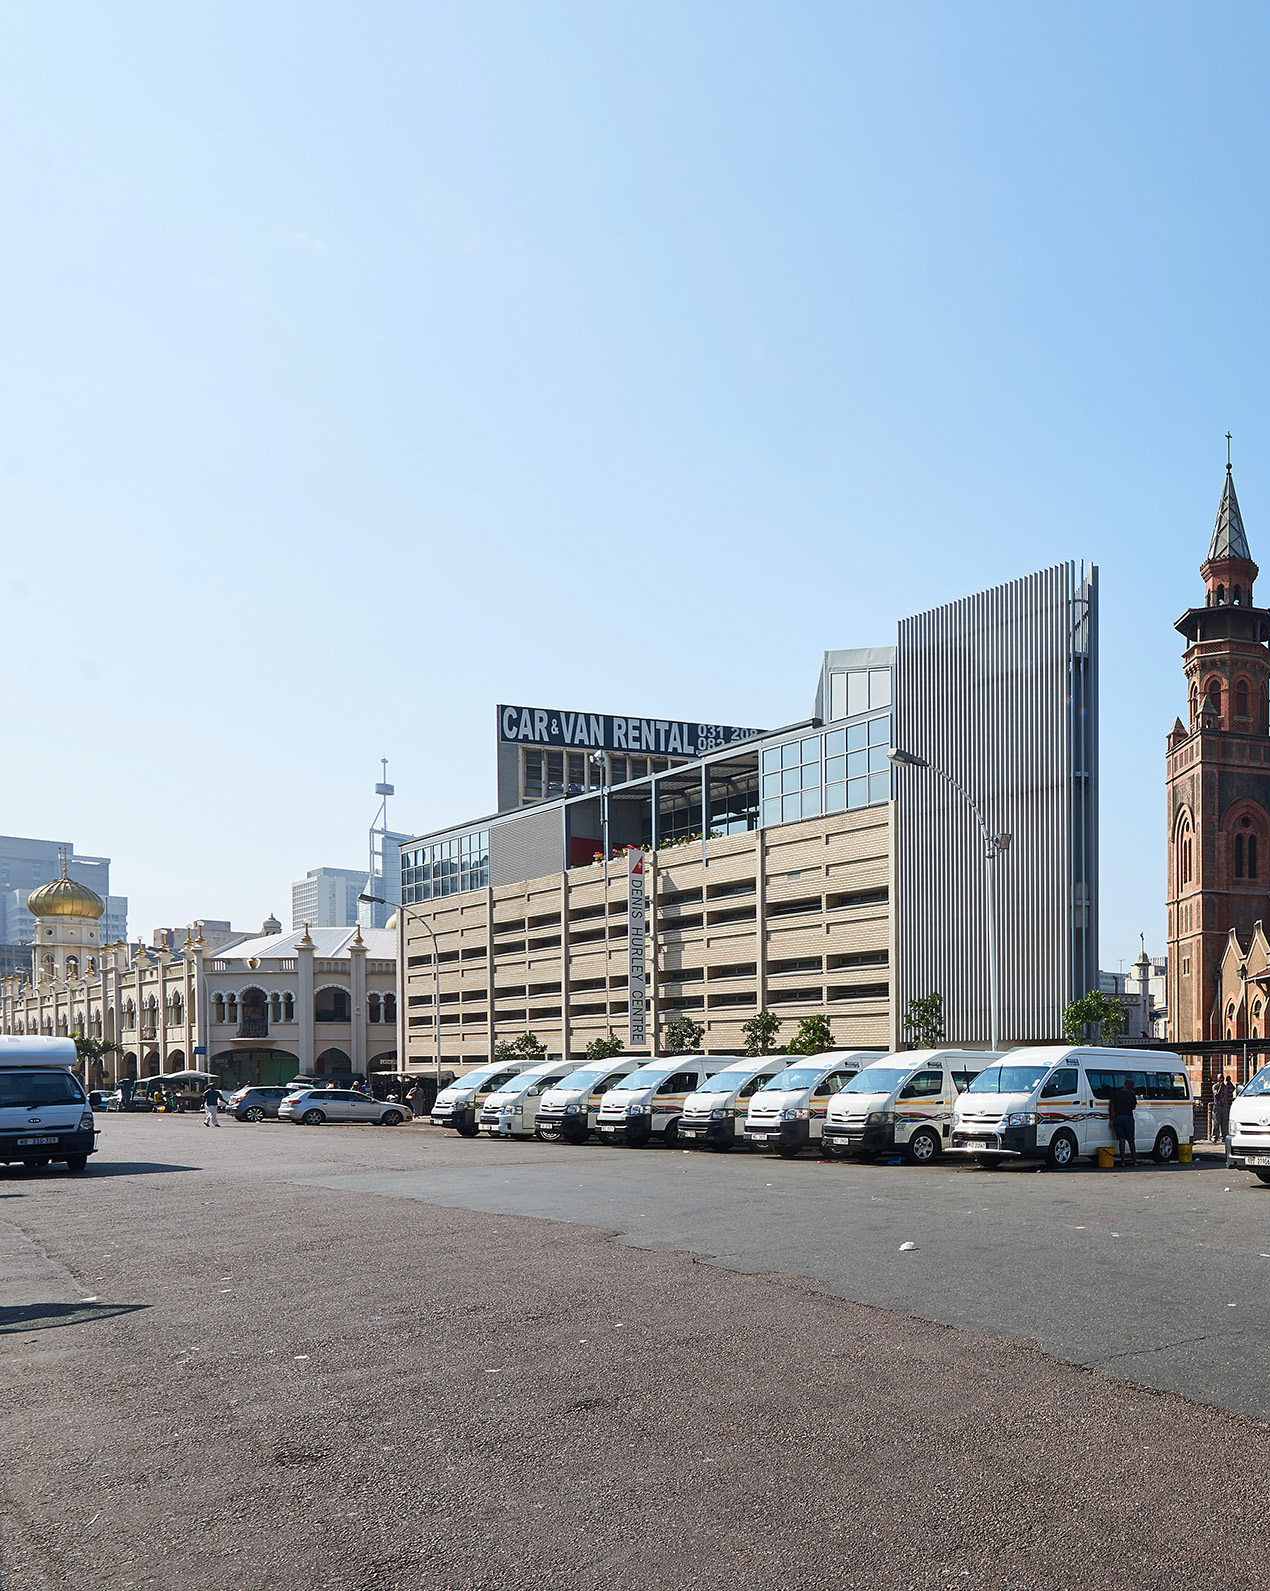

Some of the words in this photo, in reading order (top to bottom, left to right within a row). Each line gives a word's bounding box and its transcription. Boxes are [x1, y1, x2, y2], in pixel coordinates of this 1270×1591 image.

[612, 717, 694, 754] RENTAL
[697, 724, 724, 739] 031
[631, 879, 643, 919] DENIS
[631, 927, 643, 982] HURLEY
[631, 990, 644, 1042] CENTRE
